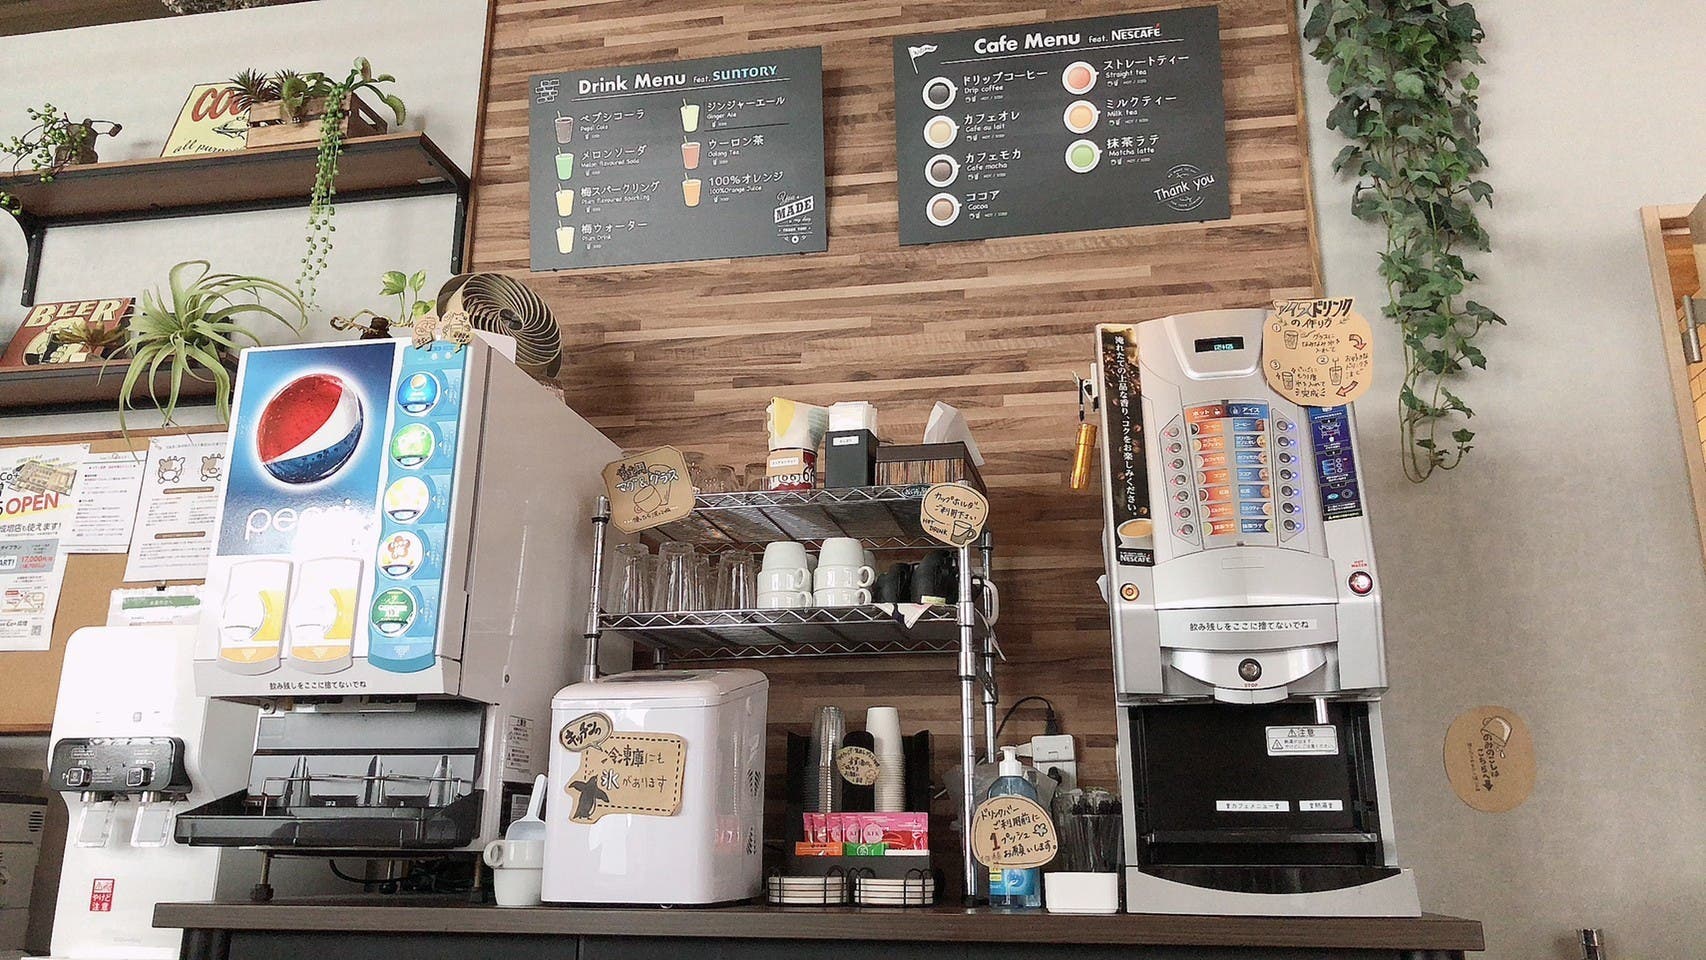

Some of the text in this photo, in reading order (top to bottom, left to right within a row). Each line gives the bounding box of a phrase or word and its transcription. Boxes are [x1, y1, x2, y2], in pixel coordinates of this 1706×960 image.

[974, 34, 1018, 54] Cafe
[1024, 32, 1081, 49] Menu
[1088, 34, 1108, 43] feat.
[1103, 55, 1189, 71] ストレートティー
[578, 65, 777, 94] Drink Menu feat. SUNTORY
[963, 70, 1048, 86] ドリップコーヒー
[1105, 69, 1133, 79] Straight
[964, 84, 1004, 95] Drip coffee
[707, 96, 786, 112] ジンジャーエール
[1106, 95, 1177, 110] ミルクティー
[580, 108, 645, 124] ペプシコーラ
[964, 110, 1020, 125] カフェオレ
[965, 125, 981, 133] Cafe
[708, 134, 764, 150] ウーロン茶
[1106, 134, 1160, 150] 抹茶ラテ
[581, 144, 647, 160] メロンソーダ
[965, 148, 1021, 164] カフェモカ
[1108, 147, 1155, 157] Matcha latte
[966, 162, 1008, 172] Cafe mocha
[708, 171, 784, 187] 100%オレンジ
[580, 180, 660, 197] 梅スパークリング
[1153, 174, 1215, 201] Thank you
[966, 190, 1000, 202] ココア
[776, 198, 812, 220] MADE
[967, 203, 989, 211] Cocoa
[581, 220, 648, 235] 梅ウォーター
[25, 298, 123, 328] BEER
[1272, 298, 1353, 318] アイスドリンク
[5, 491, 59, 515] OPEN
[1189, 621, 1309, 631] 飲み残しをここに捨てないでね
[269, 681, 367, 690] 飲み残しをここに捨てないでね
[601, 744, 665, 767] 冷凍庫にも
[601, 768, 667, 793] 氷があります
[981, 805, 1020, 821] ドリンクバー
[993, 812, 1041, 831] ご利用前に
